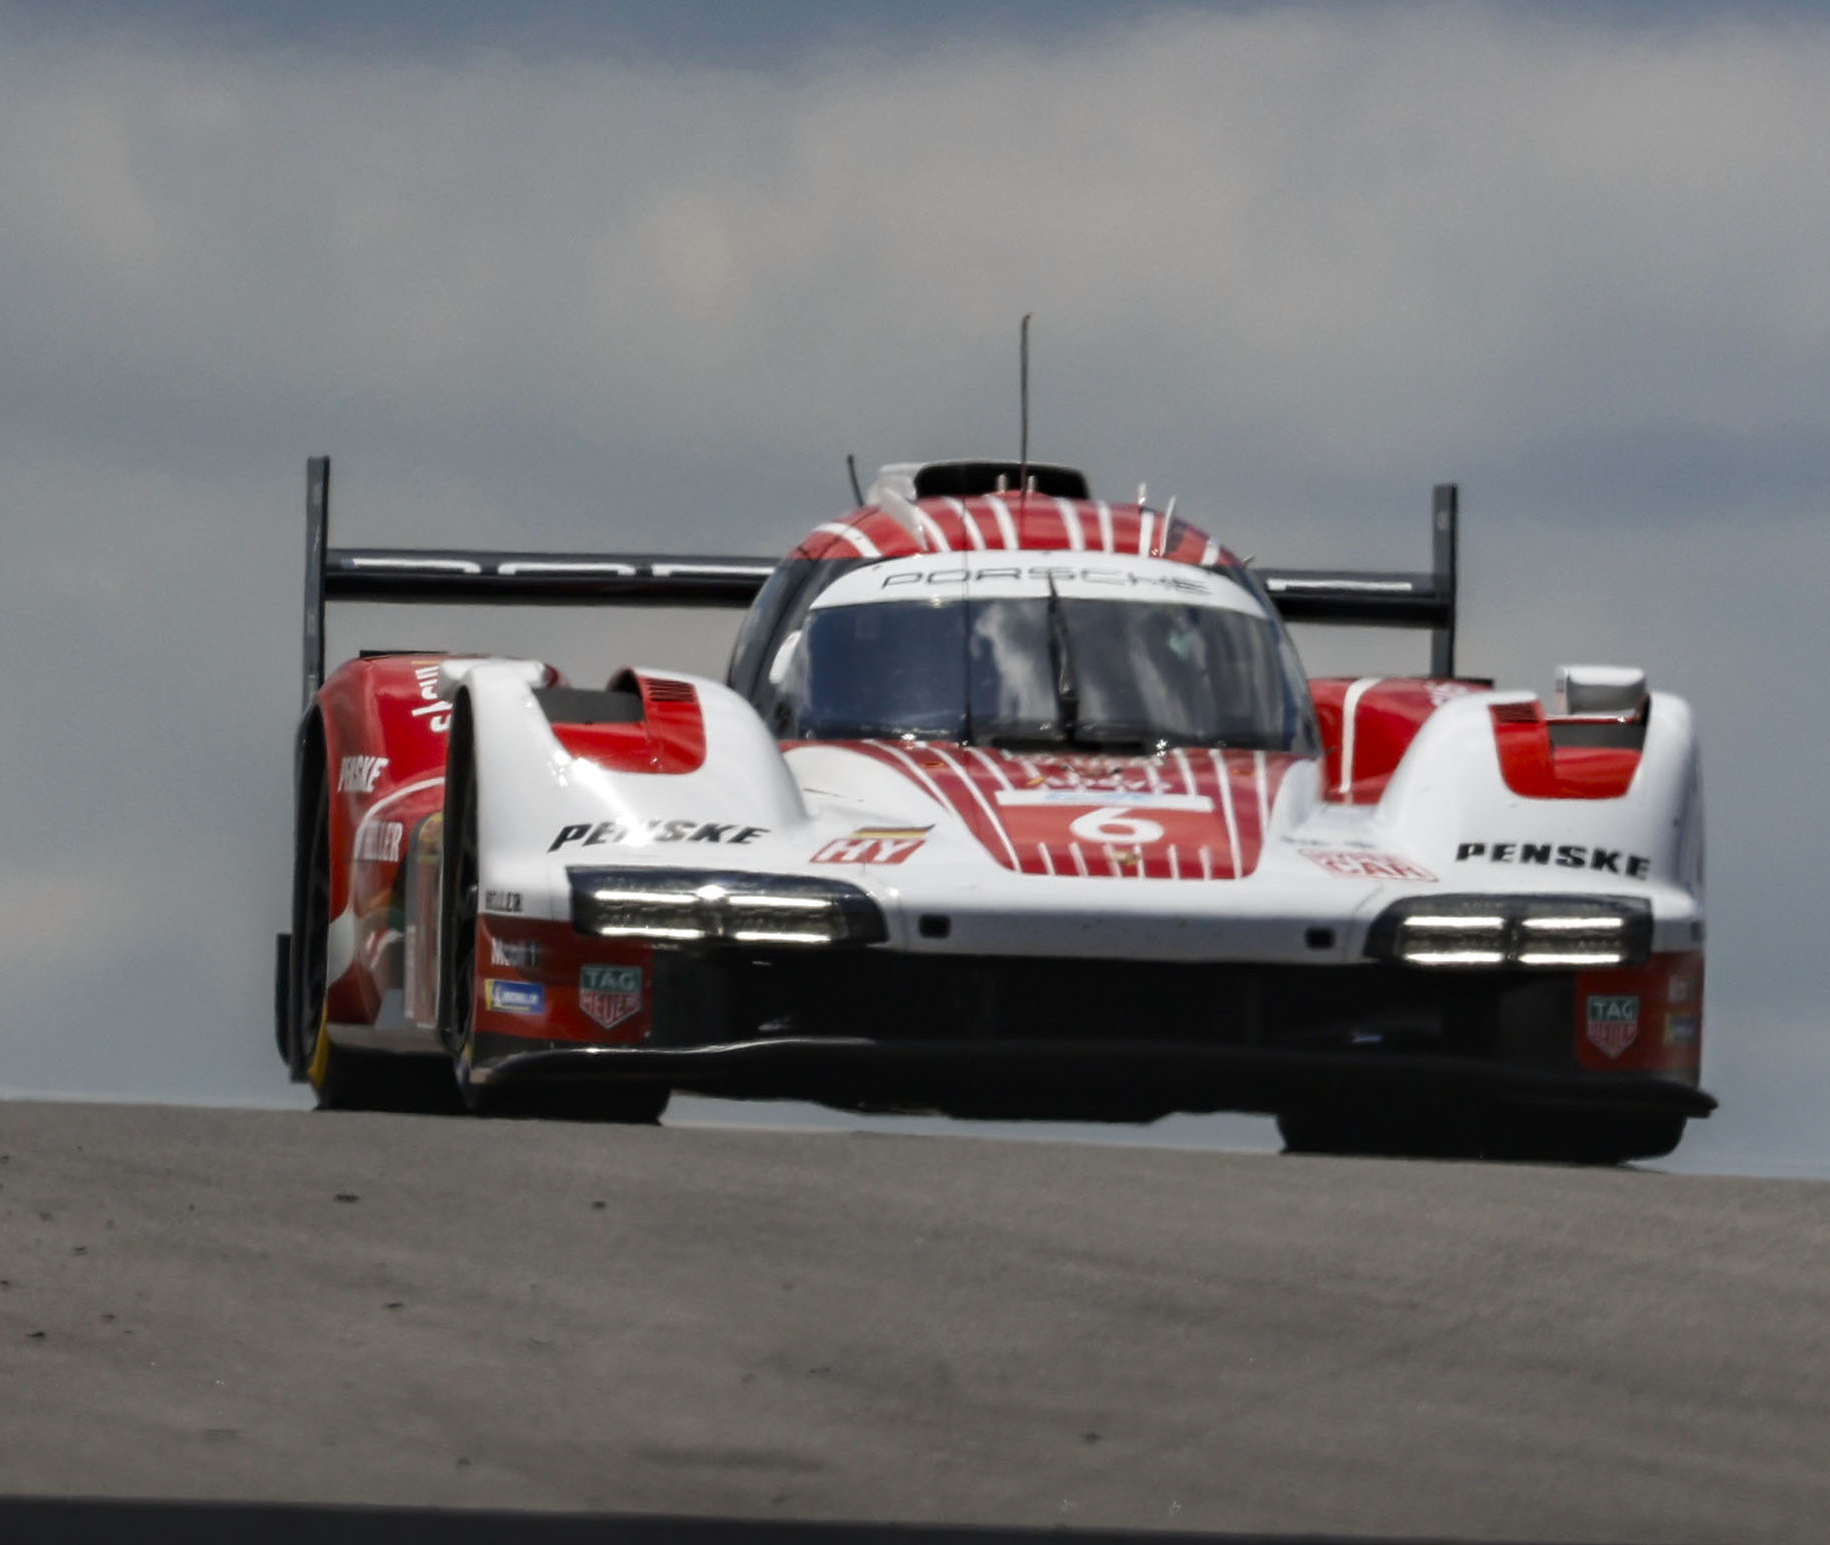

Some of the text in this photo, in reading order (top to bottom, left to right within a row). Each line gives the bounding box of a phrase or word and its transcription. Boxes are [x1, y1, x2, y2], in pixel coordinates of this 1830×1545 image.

[882, 566, 1211, 595] PORSCHE
[548, 819, 771, 853] PESKE
[1070, 807, 1164, 844] 6
[815, 838, 919, 862] HY
[1455, 842, 1651, 880] PENSKE
[585, 970, 635, 992] TAG
[1592, 1001, 1633, 1020] TAG
